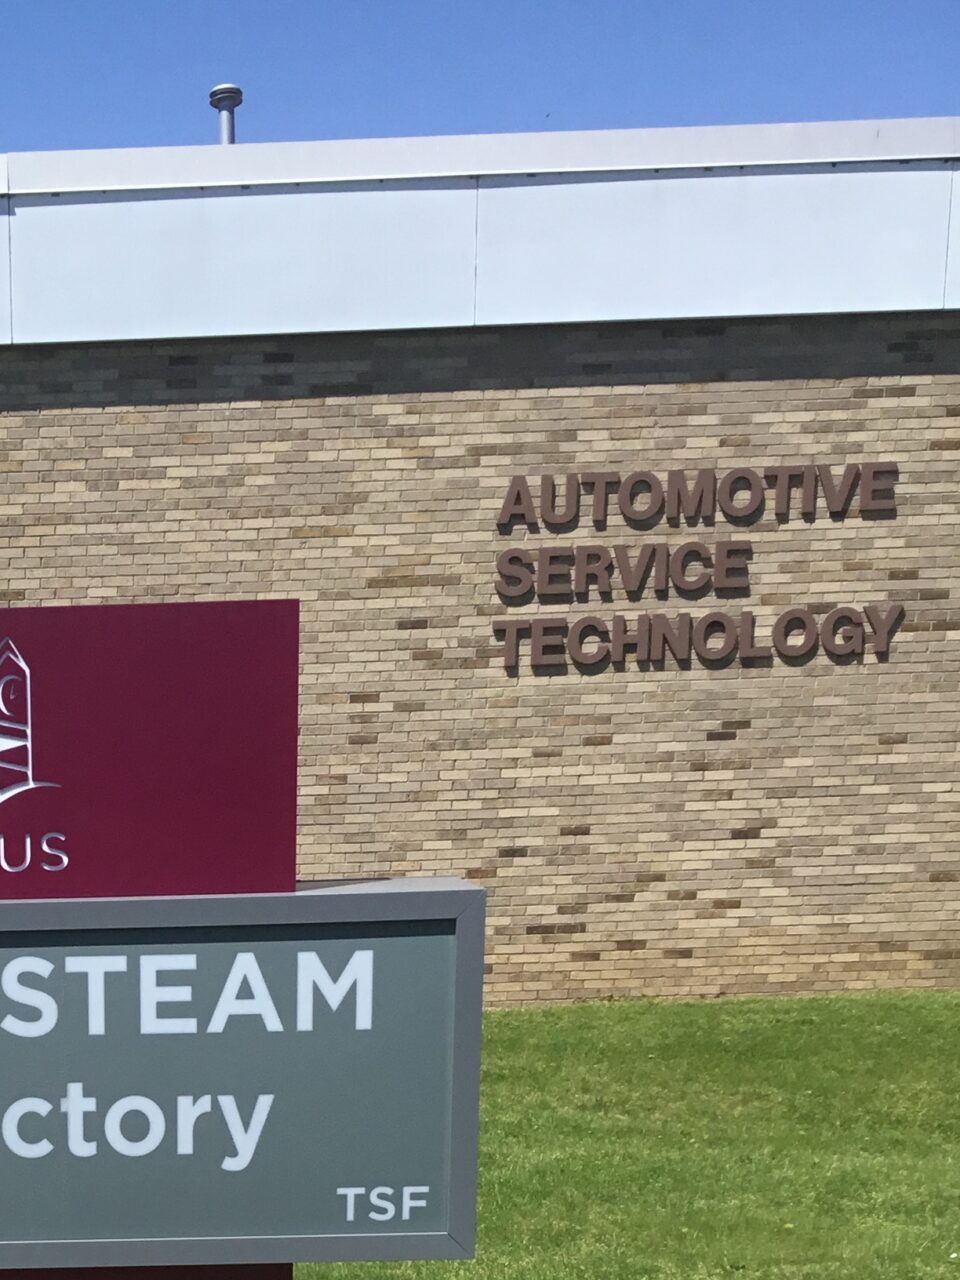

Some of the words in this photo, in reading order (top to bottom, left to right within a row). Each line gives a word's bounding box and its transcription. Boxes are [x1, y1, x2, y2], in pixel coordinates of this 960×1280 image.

[497, 462, 899, 526] AUTOMOTIVE
[495, 541, 753, 597] SERVICE
[493, 605, 904, 667] TECHNOLOGY
[0, 949, 374, 1038] STEAM
[336, 1186, 430, 1222] TSF
